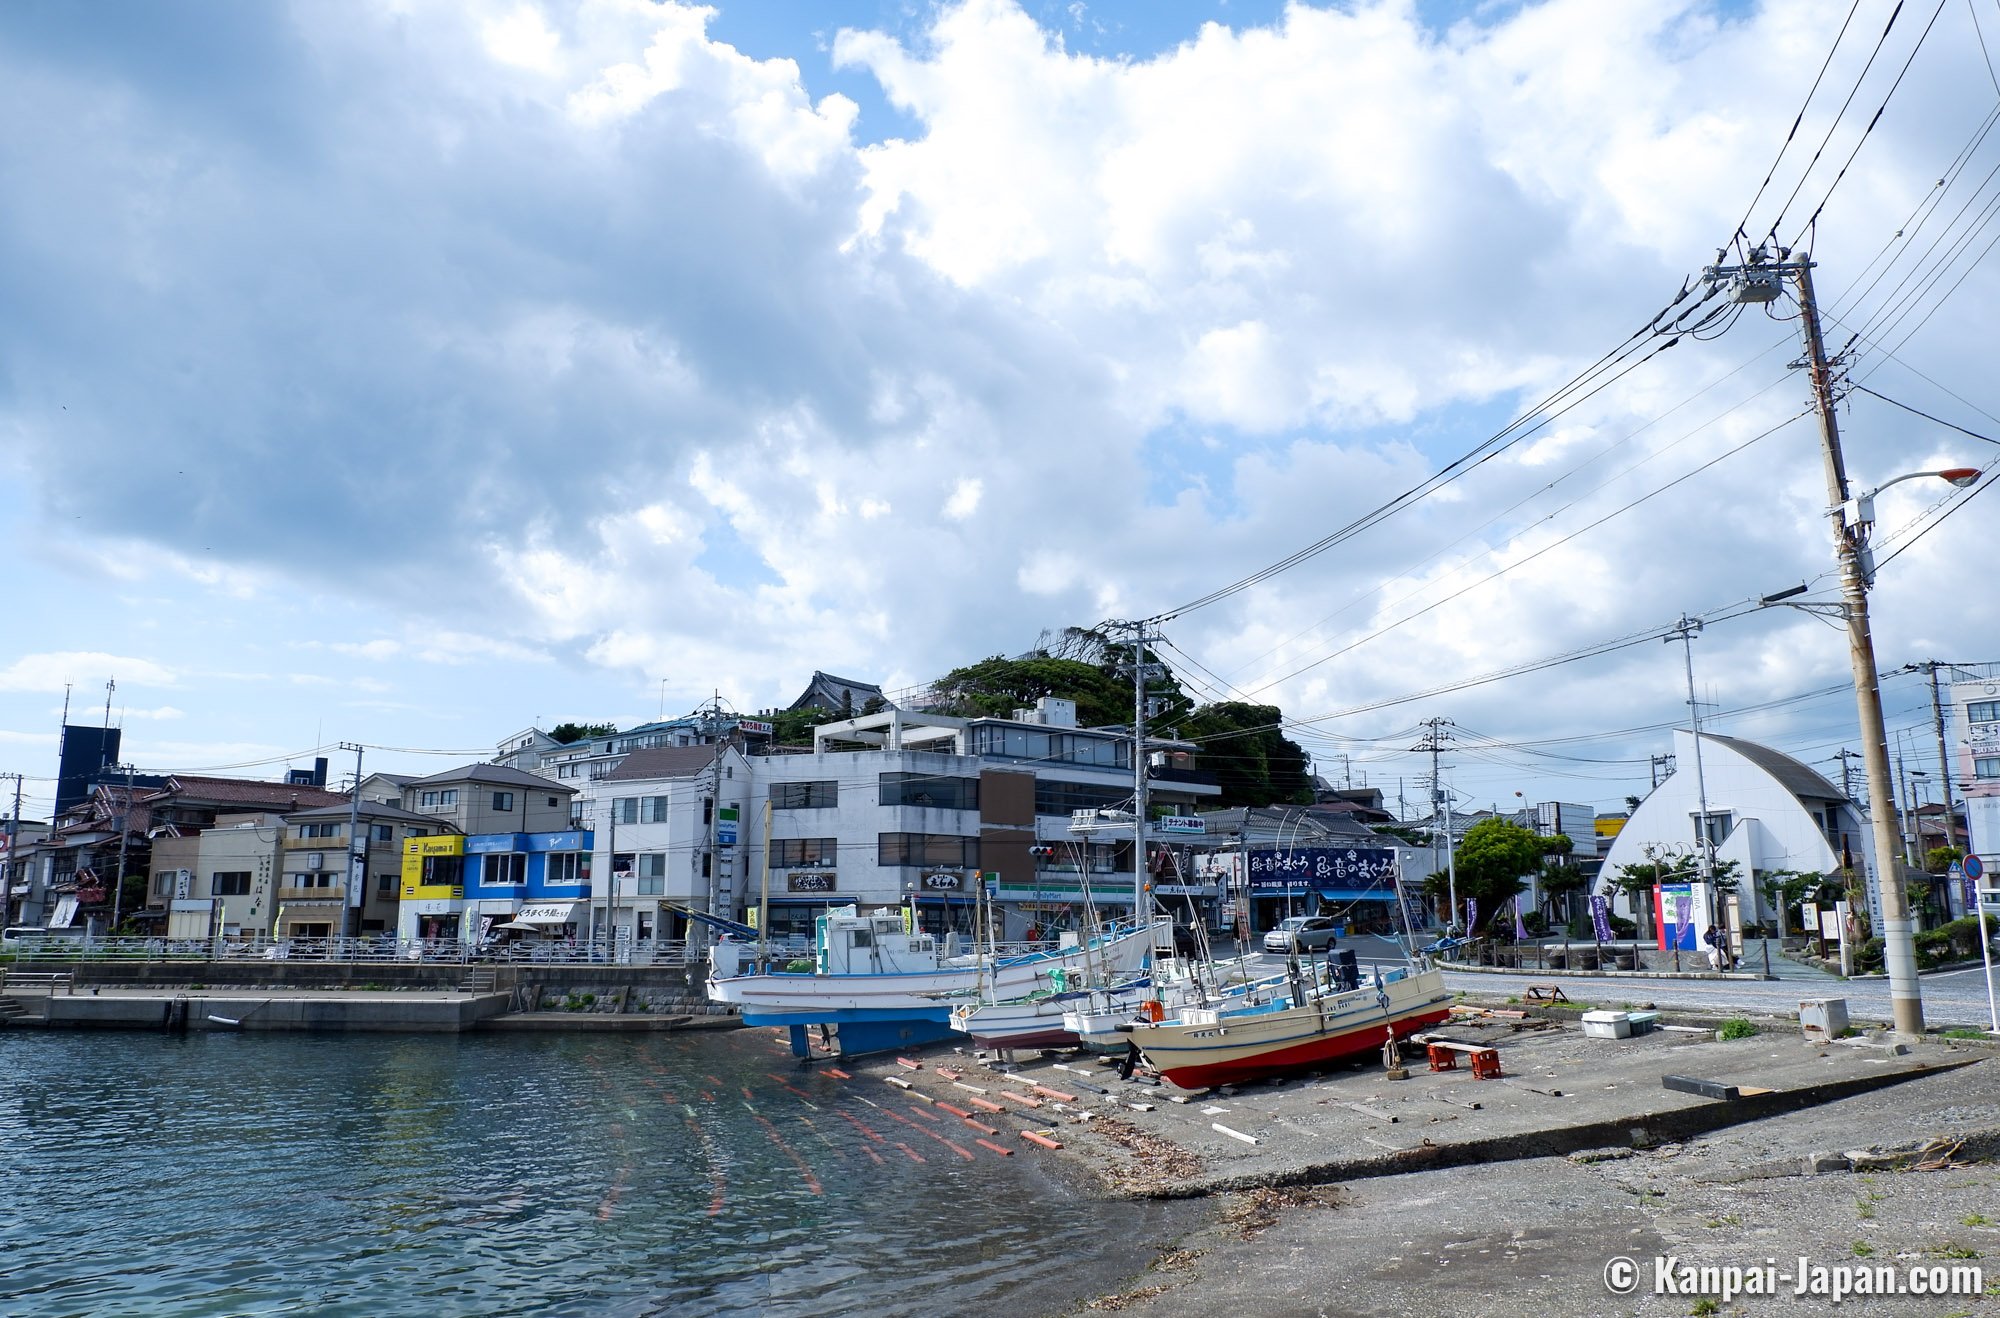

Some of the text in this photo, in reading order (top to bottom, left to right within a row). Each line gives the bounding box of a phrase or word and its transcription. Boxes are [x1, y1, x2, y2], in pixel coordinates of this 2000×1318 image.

[1168, 818, 1204, 829] テナント募集中
[1032, 891, 1062, 900] FmilyMart
[1693, 884, 1701, 910] MIURA
